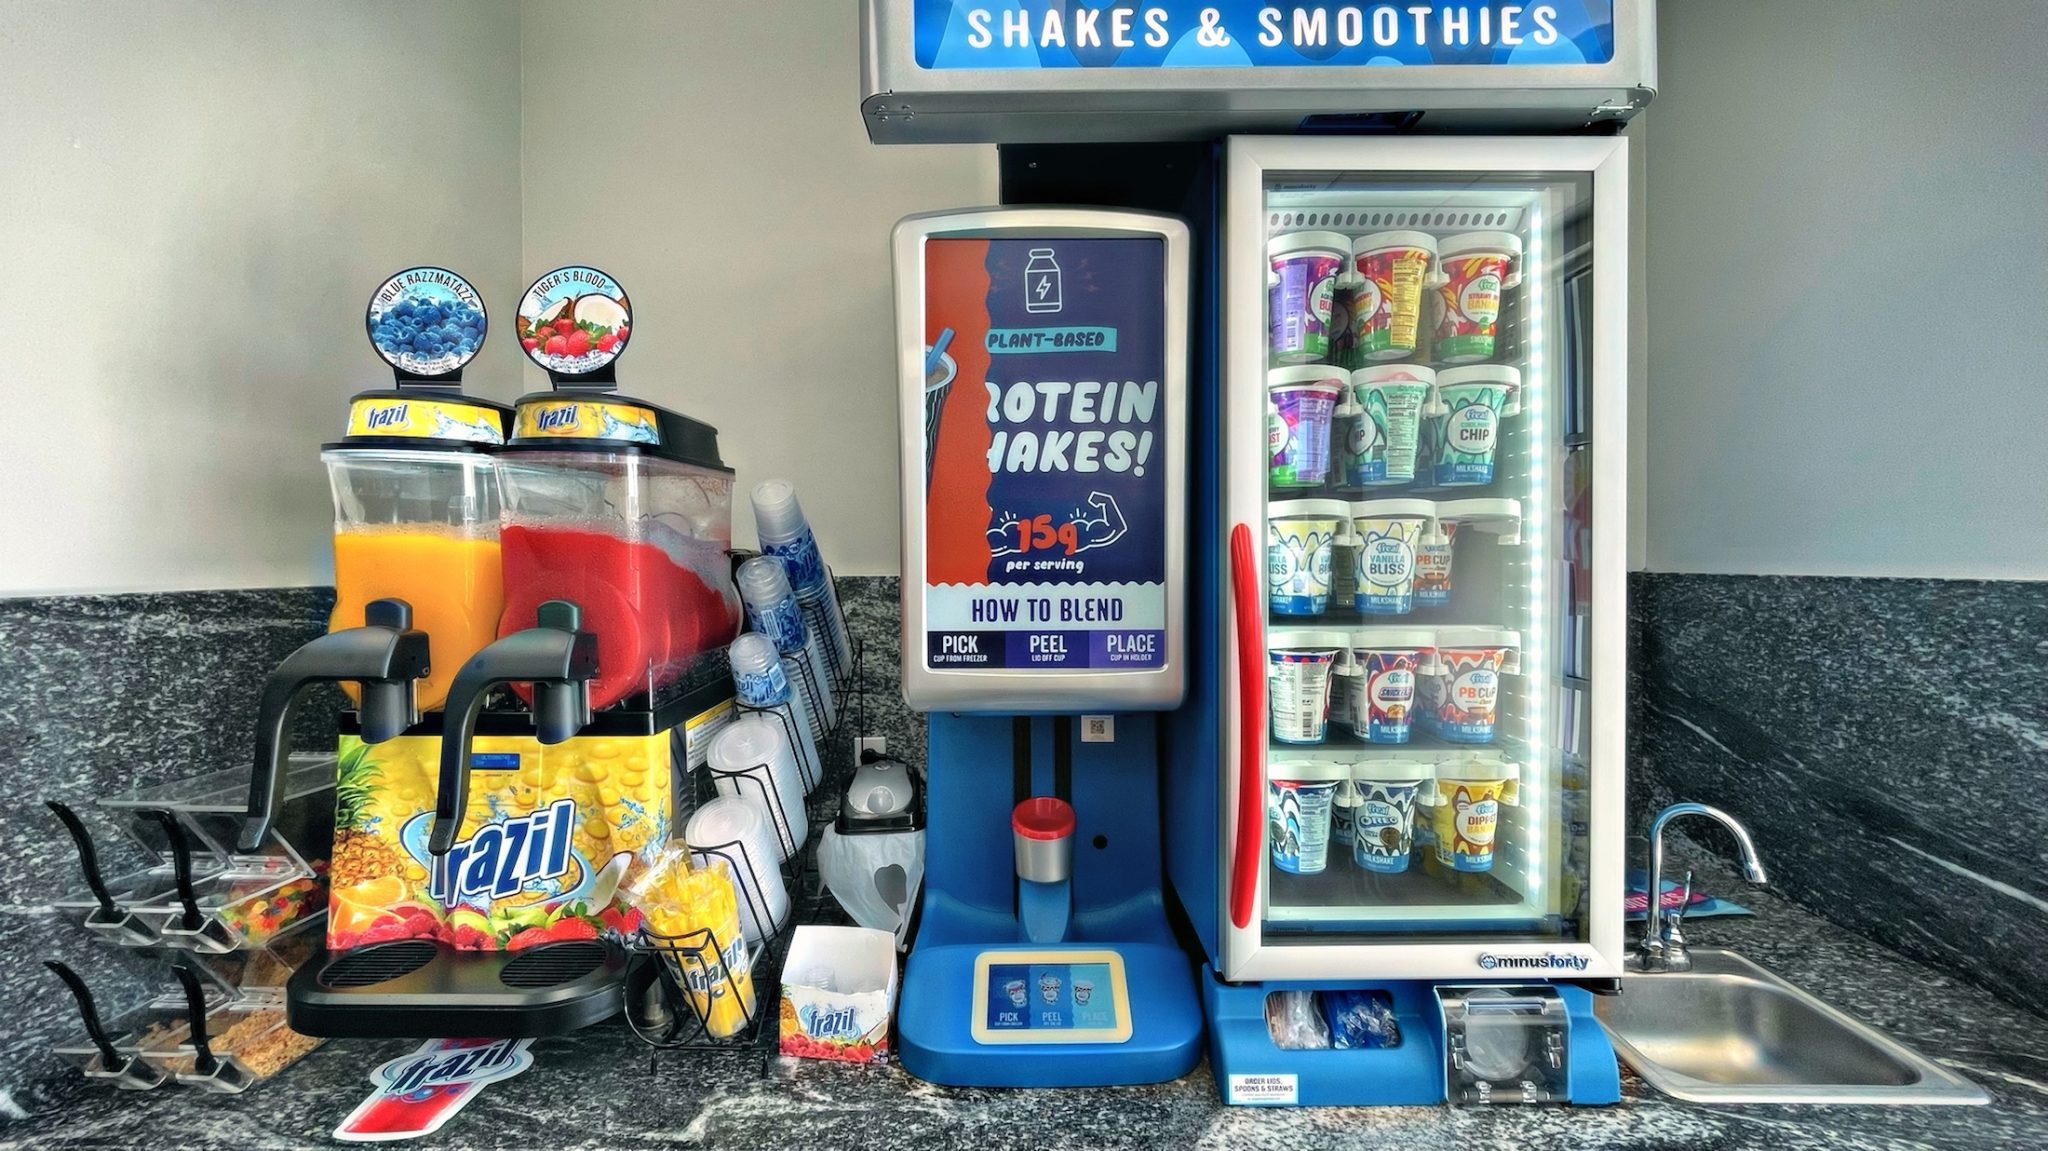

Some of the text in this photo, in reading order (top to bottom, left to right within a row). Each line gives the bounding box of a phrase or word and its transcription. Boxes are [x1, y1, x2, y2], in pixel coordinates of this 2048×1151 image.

[967, 5, 1559, 49] SHAKES & SMOOTHIES
[382, 271, 474, 302] BLUE RAZZMATAZZ
[534, 270, 606, 299] TIGER'S BLOOD
[988, 331, 1105, 349] PLANT-BASED
[366, 403, 409, 430] frazil
[537, 404, 578, 431] frazil
[1460, 429, 1490, 441] CHIP
[1016, 514, 1078, 556] 15g
[1005, 558, 1085, 574] per serving
[1370, 554, 1405, 564] VANILLA
[1417, 555, 1450, 566] PB CUP
[1370, 564, 1405, 575] BLISS
[971, 598, 1123, 622] HOW TO BLEND
[942, 634, 978, 654] PICK
[1029, 634, 1068, 654] PEEL
[1107, 634, 1156, 653] PLACE
[933, 654, 988, 662] CUP FROM FREEZER
[1031, 654, 1066, 662] LID OFF CUP
[1459, 687, 1496, 699] PB CUP
[1359, 815, 1399, 827] OREO
[1497, 954, 1590, 971] minusforty
[808, 1007, 856, 1038] frazil
[999, 1012, 1019, 1022] PICK
[1042, 1012, 1063, 1022] PEEL
[1244, 1077, 1266, 1085] ORDER
